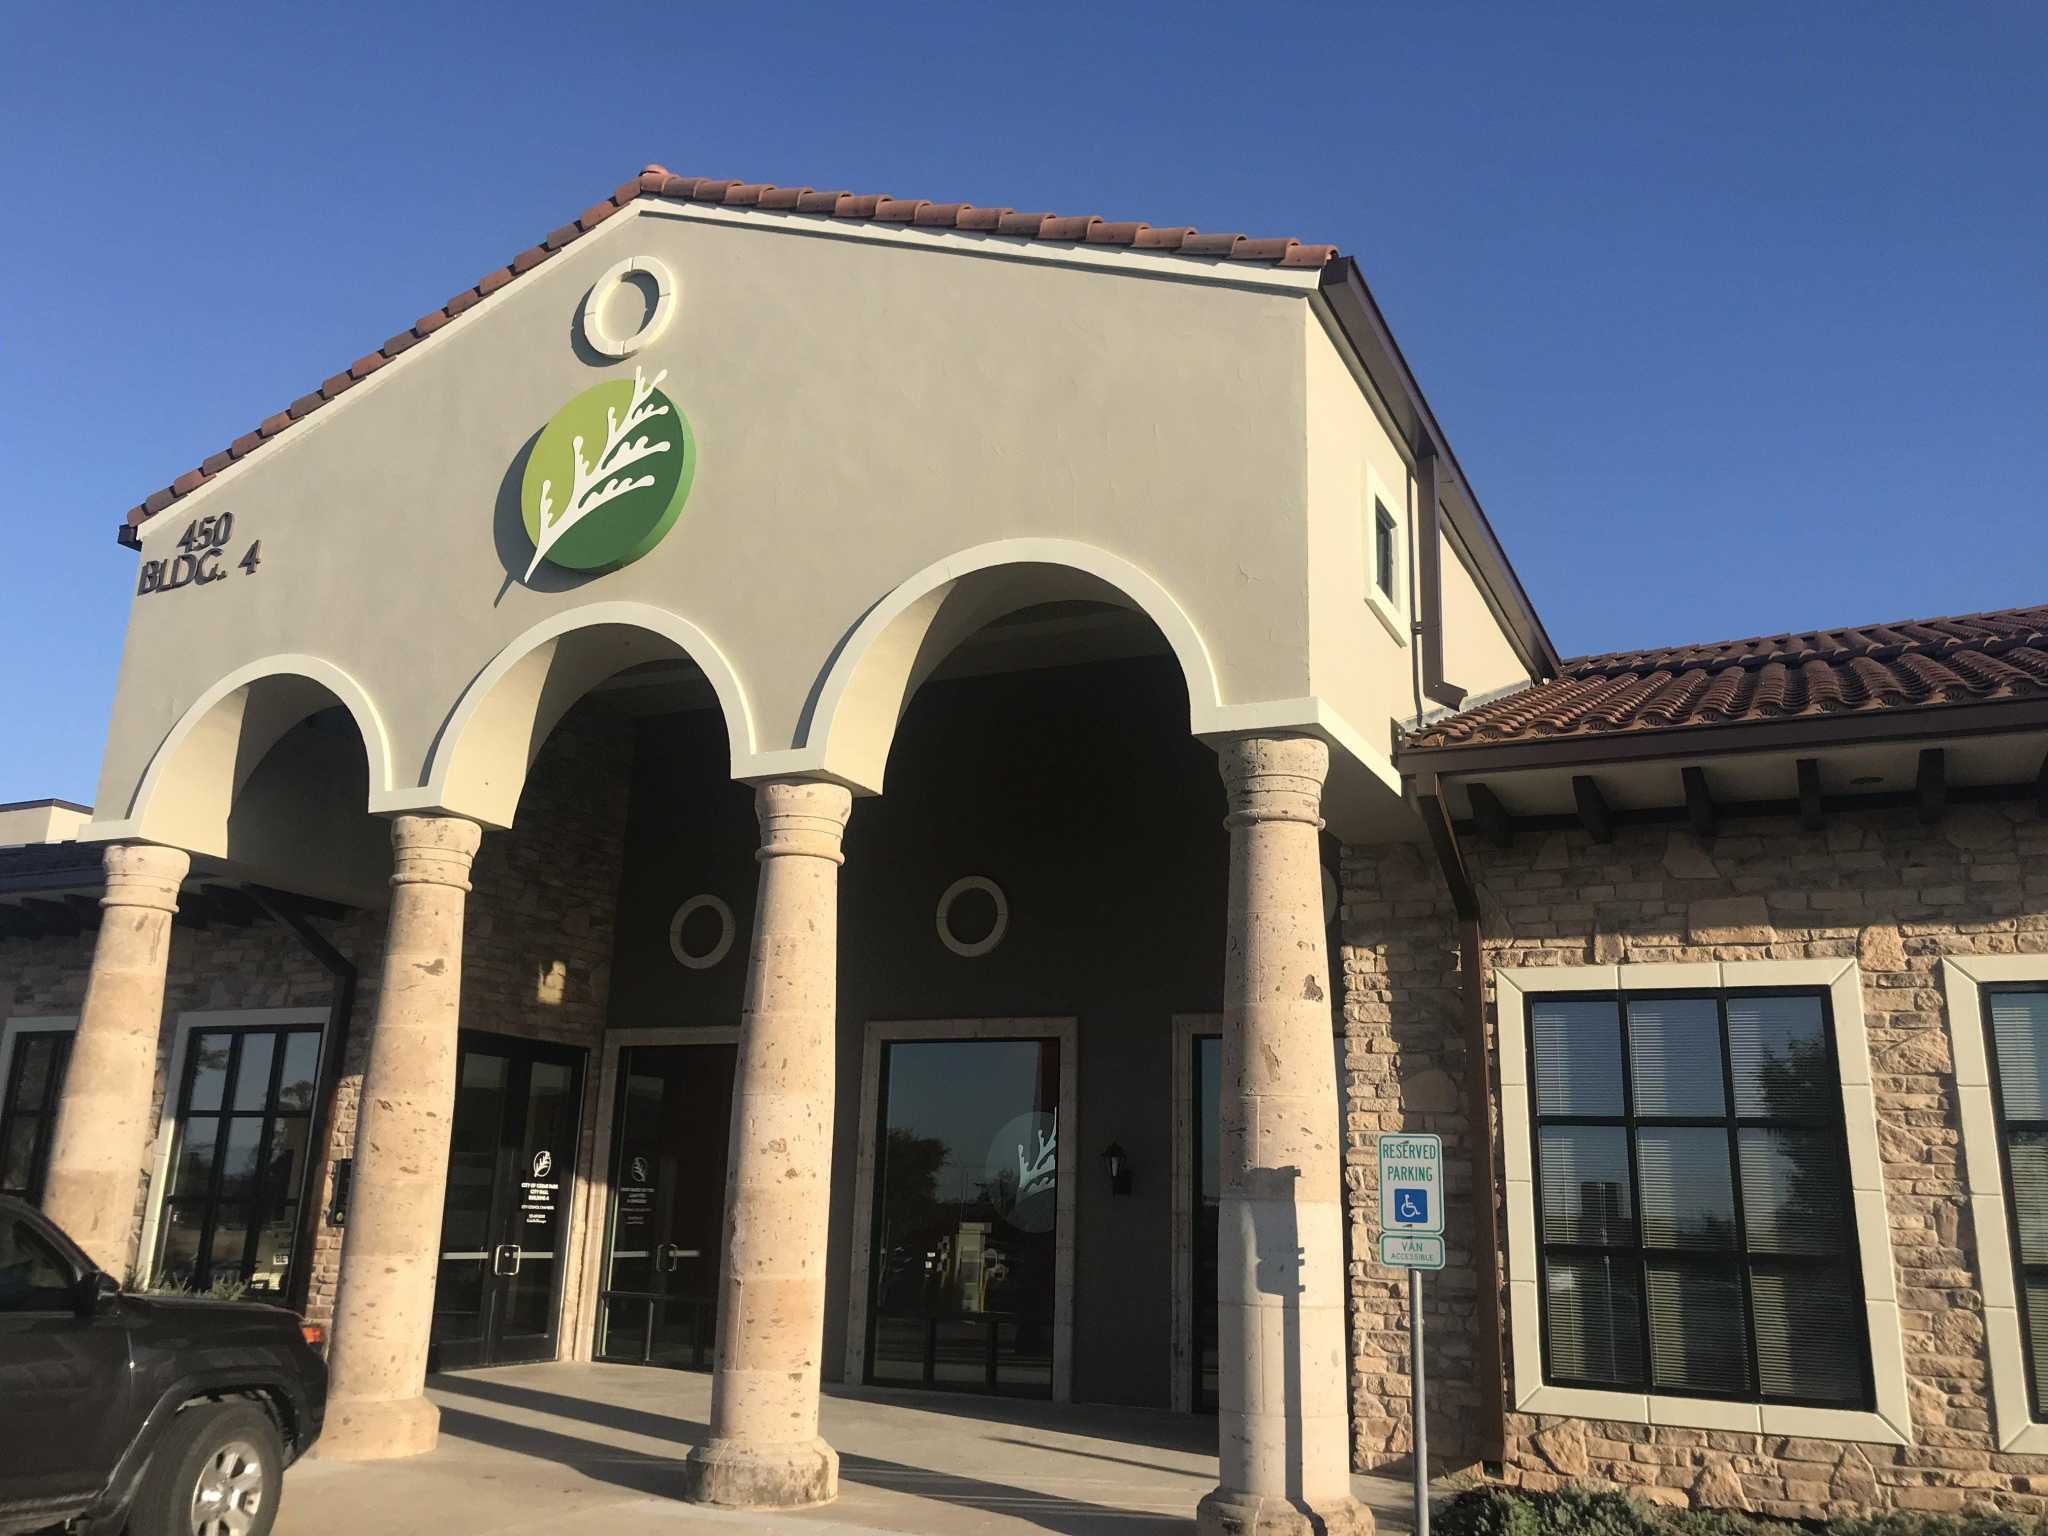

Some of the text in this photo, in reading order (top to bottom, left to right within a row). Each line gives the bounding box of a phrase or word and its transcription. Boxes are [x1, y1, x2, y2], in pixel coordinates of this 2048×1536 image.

[176, 511, 233, 554] 450
[137, 539, 261, 596] BLDG. 4
[1382, 1143, 1436, 1160] RESERVED
[1387, 1165, 1433, 1181] PARKING
[1401, 1241, 1424, 1252] VAN
